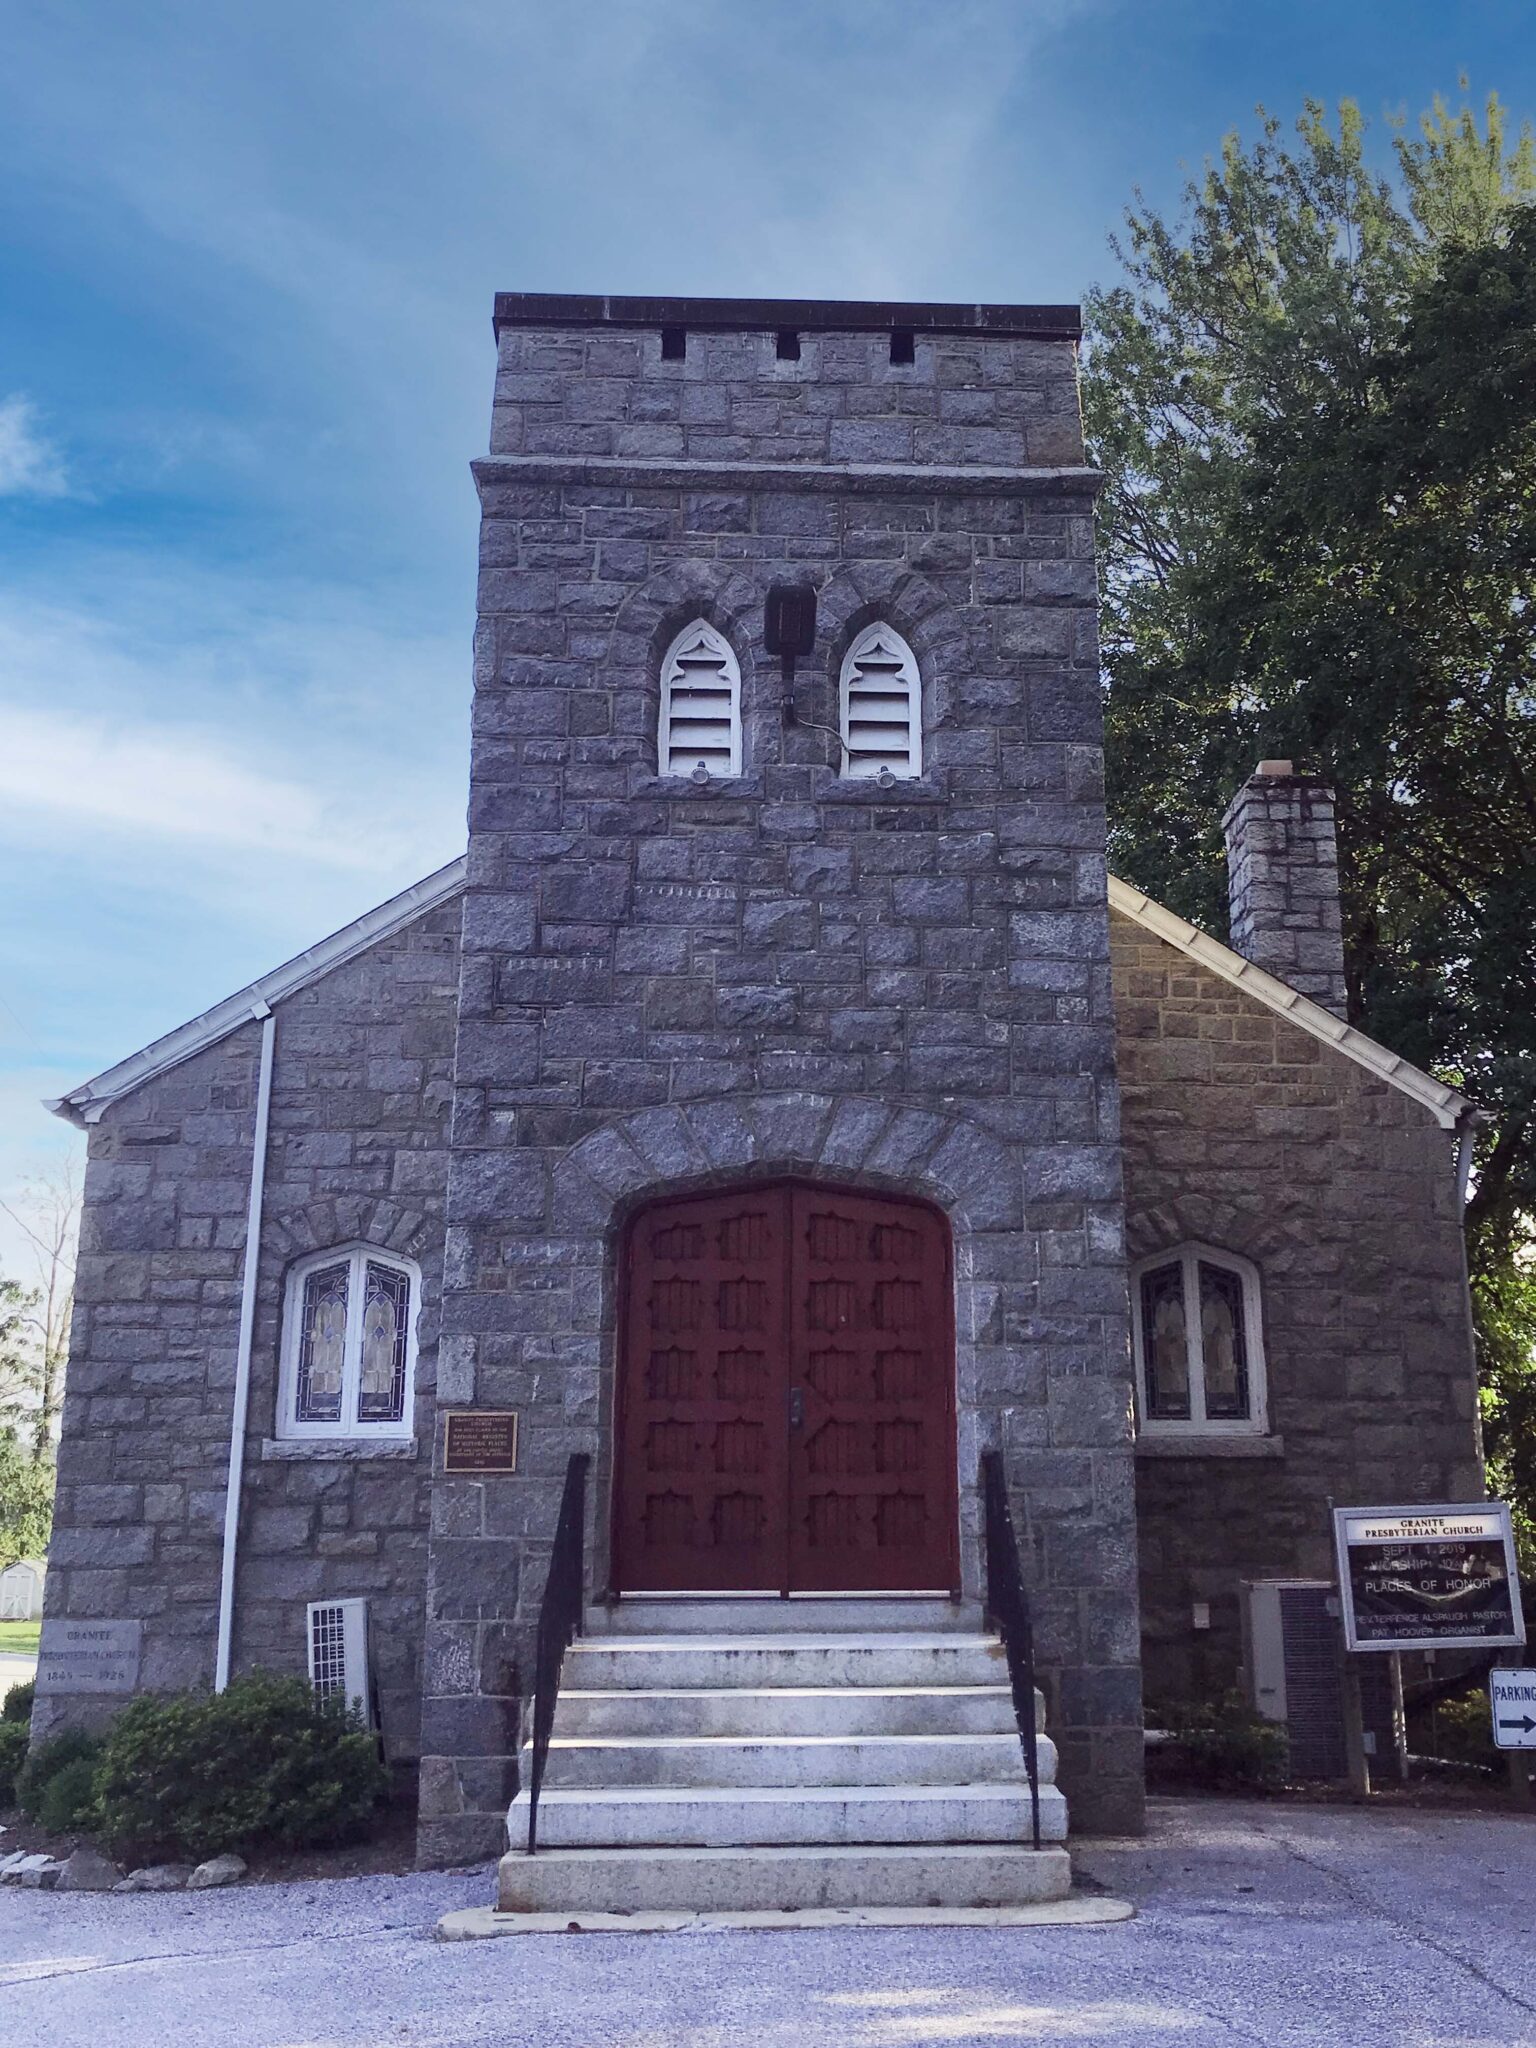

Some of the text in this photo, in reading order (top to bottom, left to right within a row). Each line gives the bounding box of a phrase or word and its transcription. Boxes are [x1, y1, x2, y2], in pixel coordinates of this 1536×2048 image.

[1401, 1519, 1445, 1529] GRANITE
[1365, 1526, 1483, 1538] PRESBYTERIAN CHURCH
[1382, 1545, 1413, 1557] SEPT
[1365, 1578, 1491, 1593] PLACES OF HONOR
[1472, 1610, 1507, 1620] PASTOR
[67, 1631, 113, 1641] GRANITE
[1371, 1625, 1486, 1638] PAT HOOVER ORGANIST
[1494, 1686, 1536, 1701] PARKING
